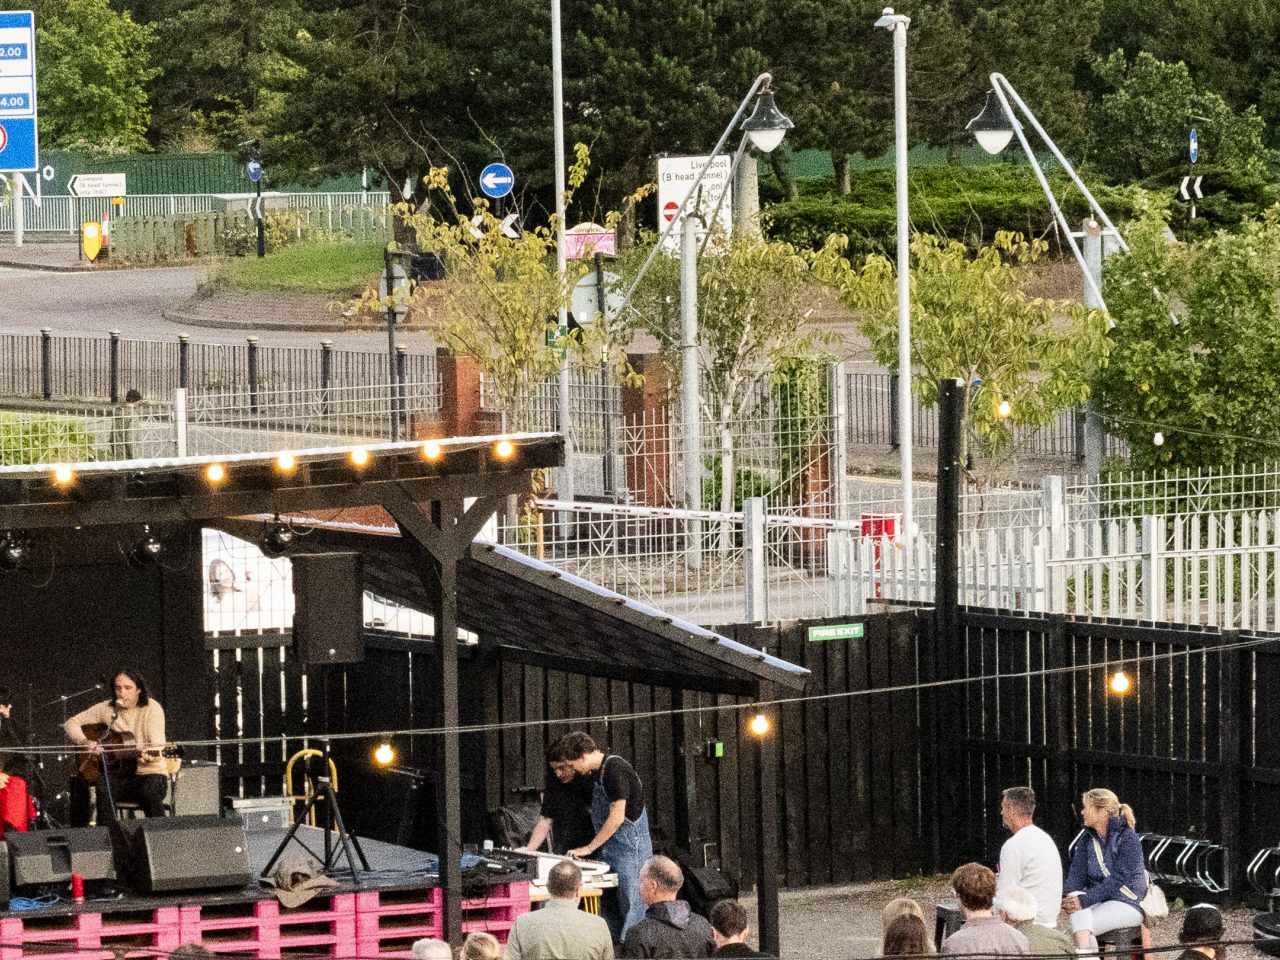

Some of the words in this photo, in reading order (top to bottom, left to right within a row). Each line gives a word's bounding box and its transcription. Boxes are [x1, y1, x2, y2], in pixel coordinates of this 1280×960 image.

[691, 160, 727, 169] Livepool
[698, 170, 728, 180] unnel)
[710, 181, 727, 191] onl
[812, 628, 835, 638] FIRE
[837, 627, 860, 635] EXIT
